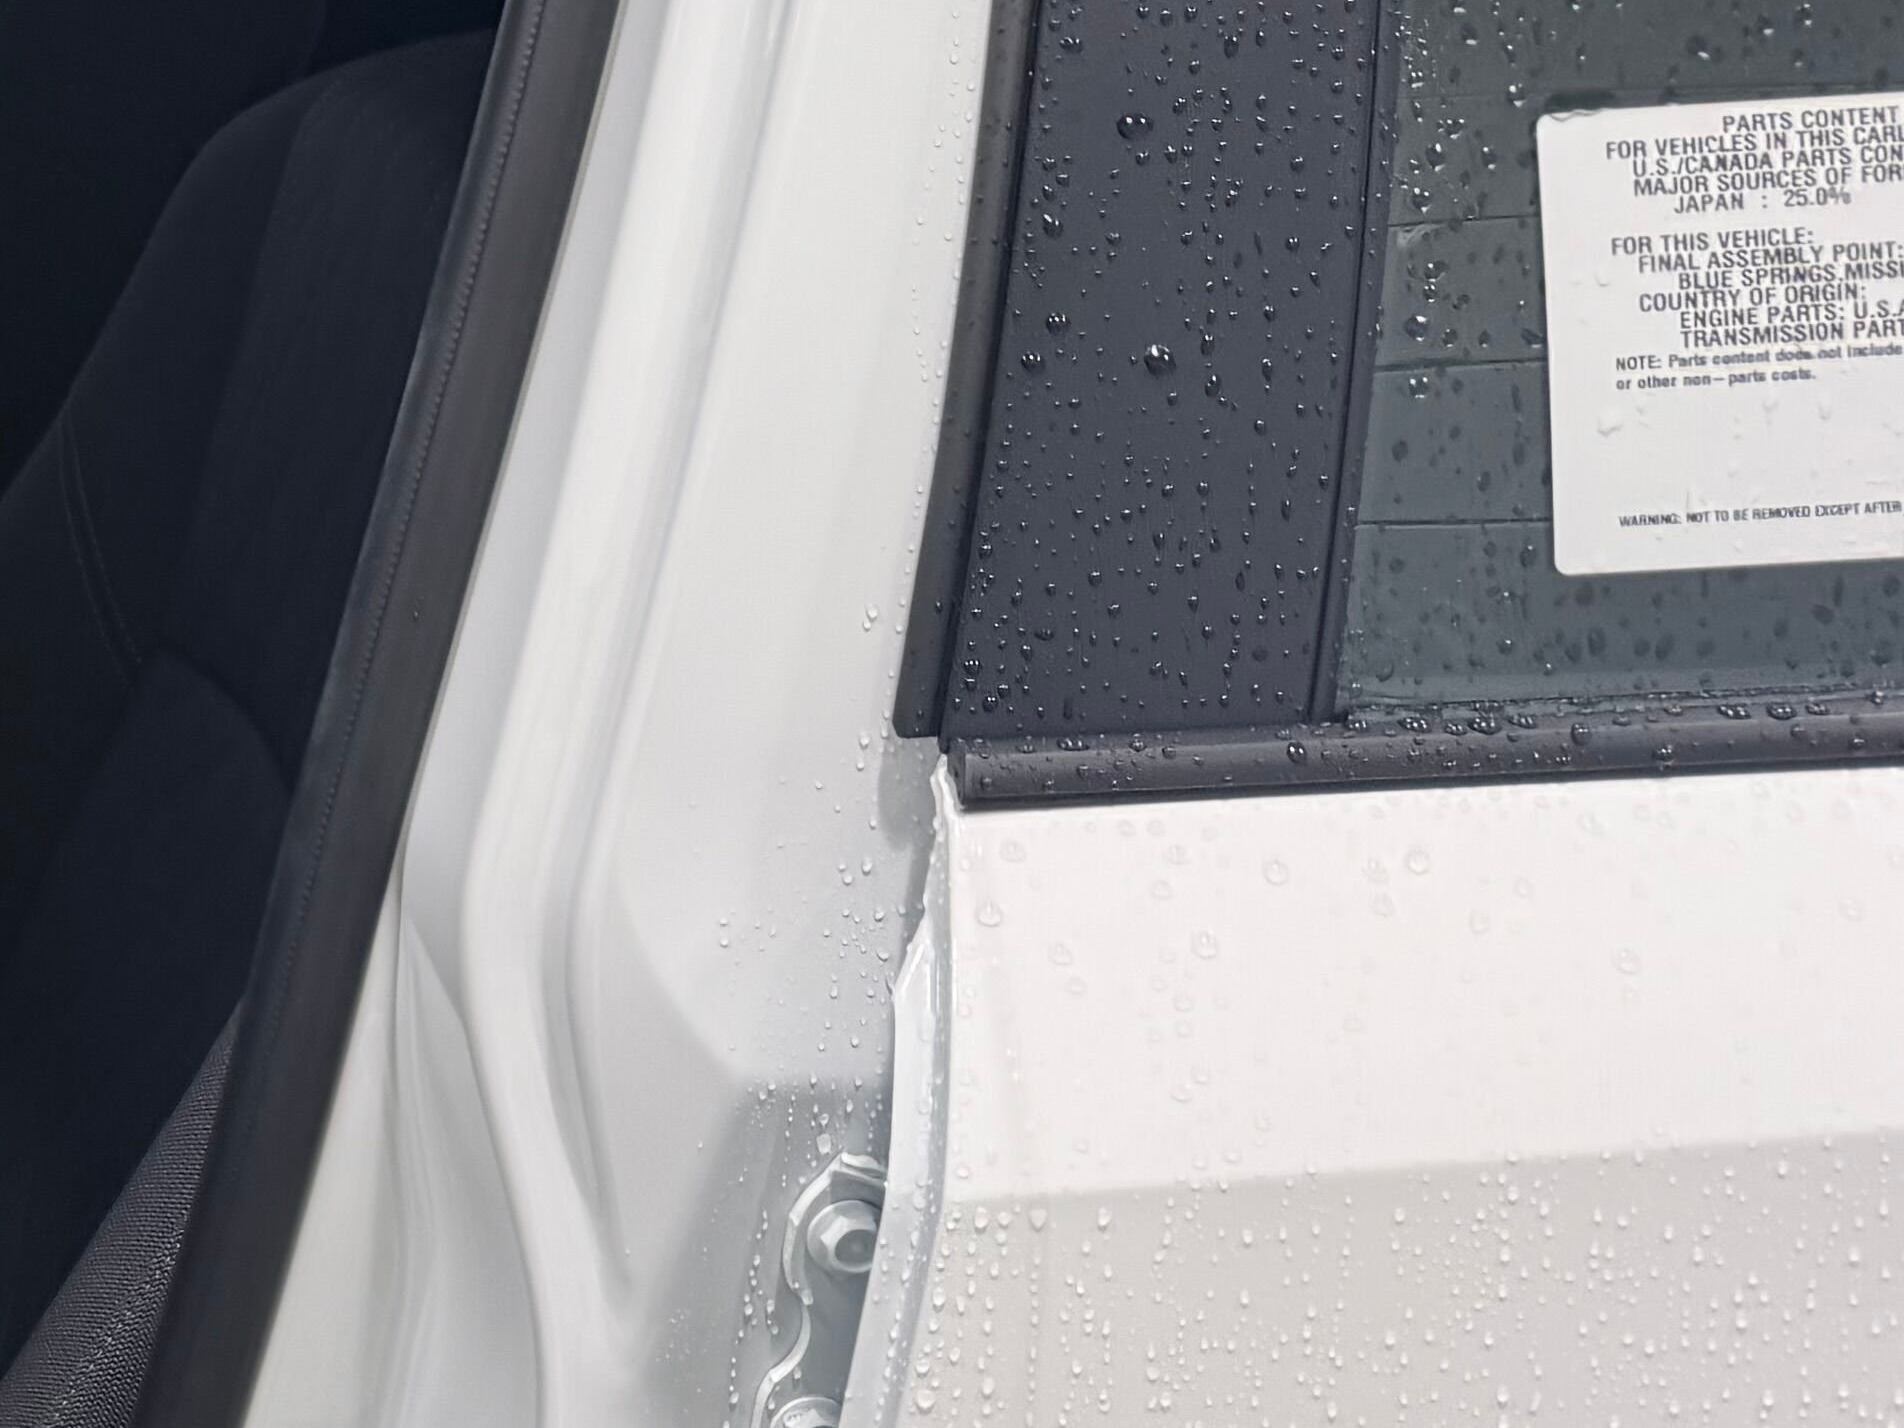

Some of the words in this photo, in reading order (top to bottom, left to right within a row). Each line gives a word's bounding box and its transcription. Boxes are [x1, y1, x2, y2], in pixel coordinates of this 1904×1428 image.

[1723, 112, 1793, 133] PARTS
[1802, 106, 1899, 128] CONTENT
[1607, 141, 1646, 159] FOR
[1655, 134, 1756, 155] VEHICLES
[1766, 133, 1786, 149] IN
[1796, 130, 1844, 147] THIS
[1633, 152, 1772, 177] U.S./CANADA
[1782, 149, 1851, 168] PARTS
[1634, 175, 1708, 196] MAJOR
[1717, 169, 1816, 191] SOURCES
[1825, 167, 1851, 184] OF
[1674, 192, 1744, 213] JAPAN
[1784, 187, 1851, 206] 25.0%
[1611, 236, 1652, 255] FOR
[1660, 233, 1708, 252] THIS
[1718, 228, 1813, 249] VEHICLE:
[1639, 255, 1699, 273] FINAL
[1707, 245, 1822, 268] ASSEMBLY
[1833, 242, 1904, 261] POINT:
[1679, 271, 1732, 290] BLUE
[1640, 289, 1740, 312] COUNTRY
[1750, 289, 1775, 305] OF
[1785, 283, 1865, 304] ORIGIN:
[1680, 308, 1757, 329] ENGINE
[1768, 304, 1844, 324] PARTS:
[1680, 322, 1843, 348] TRANSMISSION
[1616, 357, 1661, 371] NOTE:
[1669, 354, 1707, 368] Parts
[1713, 351, 1769, 365] content
[1616, 377, 1630, 390] or
[1638, 375, 1676, 388] other
[1687, 512, 1711, 523] NOT
[1715, 510, 1729, 522] TO
[1733, 509, 1748, 521] BE
[1752, 506, 1810, 520] REMOVED
[1815, 503, 1860, 517] EXCEPT
[1864, 501, 1902, 513] AFTER
